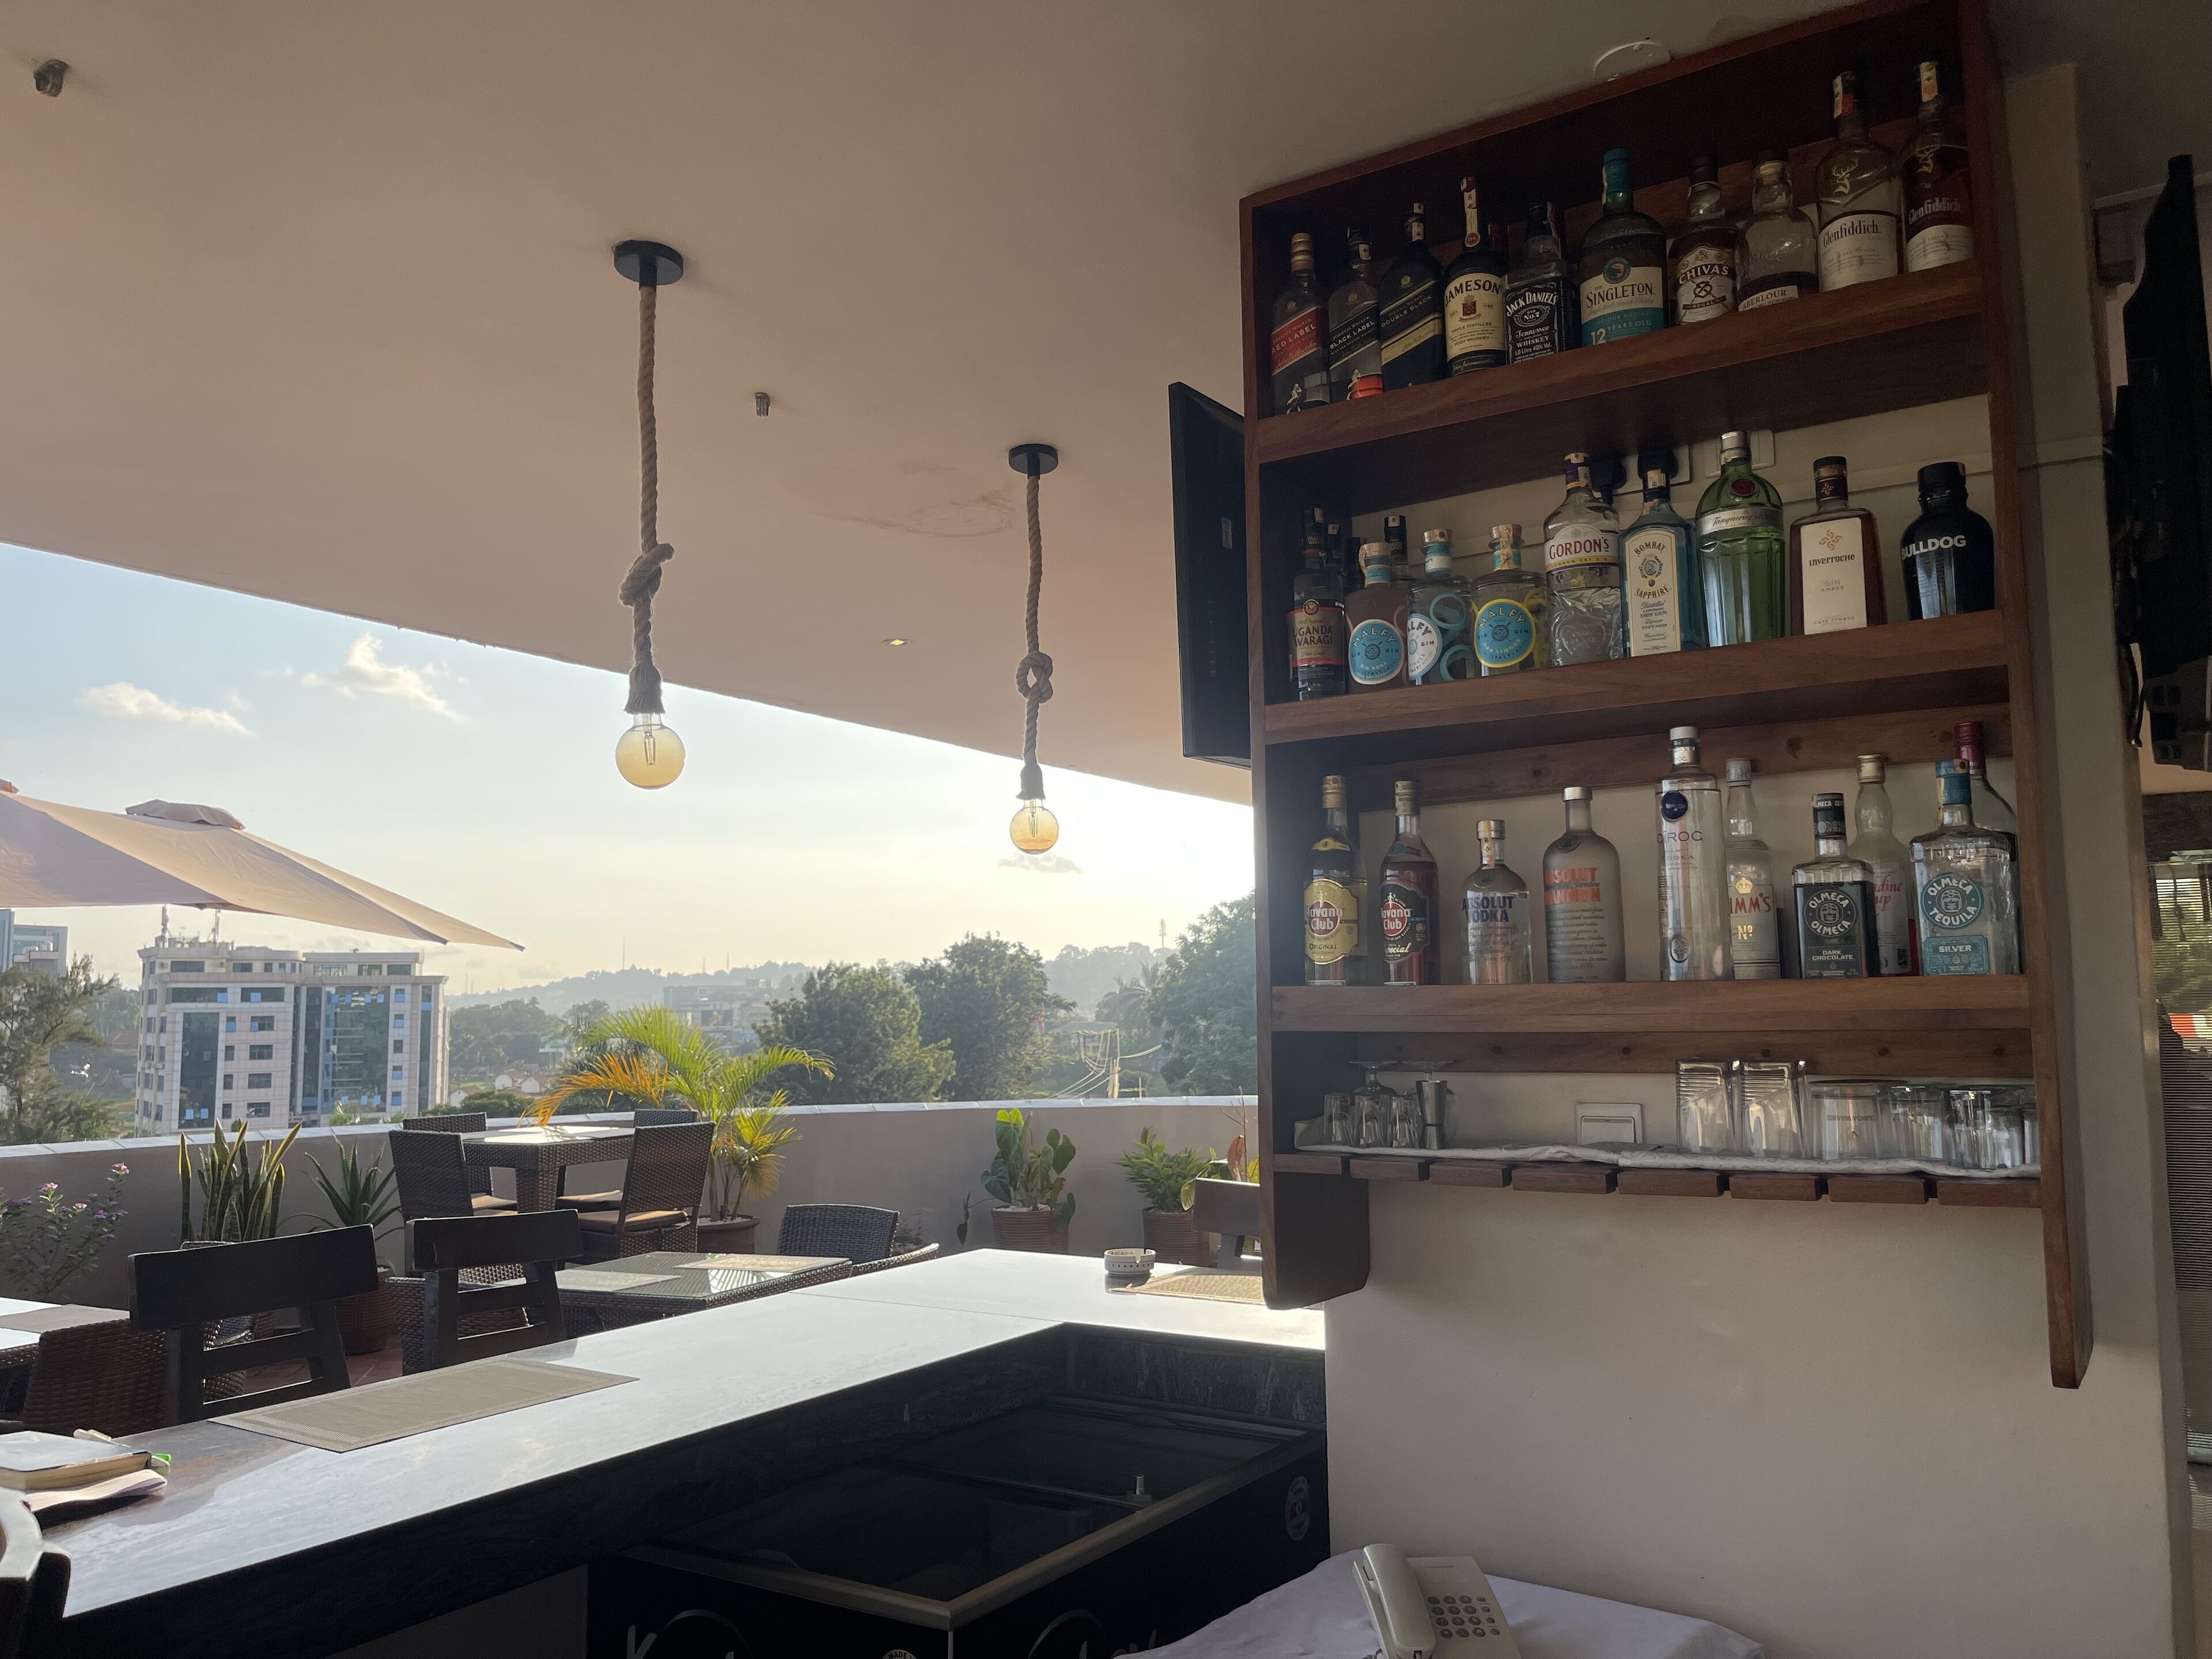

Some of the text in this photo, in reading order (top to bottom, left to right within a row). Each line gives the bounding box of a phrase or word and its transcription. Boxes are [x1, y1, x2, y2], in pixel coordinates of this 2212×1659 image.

[1823, 219, 1879, 248] Glenfiddich
[1679, 265, 1729, 285] CHIVAS
[1445, 279, 1501, 307] JAMESON
[1587, 282, 1653, 308] SINGLETON
[1743, 289, 1787, 310] ABERLOUR
[1381, 295, 1433, 328] DOUBLE BLACK
[1506, 297, 1526, 317] JACK
[1693, 300, 1714, 308] REGAL
[1289, 323, 1317, 343] LABEL
[1516, 325, 1550, 338] Tennessee
[1607, 321, 1633, 331] YEARS
[1330, 321, 1376, 350] BLACK LABEL
[1517, 335, 1550, 347] WHISKEY
[1591, 328, 1606, 345] 12
[1712, 514, 1752, 527] Tanqueray
[1549, 537, 1609, 560] GORDON'S
[1634, 541, 1666, 555] BOMBAY
[1902, 535, 1967, 560] BULLDOG
[1551, 559, 1575, 568] LONDON
[1824, 578, 1840, 587] GIN
[1635, 585, 1670, 599] SAPPHIRE
[1480, 607, 1526, 628] MALFY
[1292, 626, 1333, 638] UGANDA
[1353, 626, 1396, 647] MALFY
[1407, 621, 1432, 637] ALFY
[1294, 635, 1332, 647] WARAGI
[1927, 877, 1973, 896] OLMECA
[1729, 893, 1771, 914] IMM'S
[1809, 892, 1850, 909] OLMECA
[1306, 906, 1343, 918] Havana
[1929, 906, 1978, 926] TEQUILA
[1310, 918, 1334, 931] Club
[1384, 919, 1402, 930] Club
[1811, 921, 1851, 935] OLMECA
[1385, 942, 1412, 954] pecial
[1939, 945, 1972, 953] SILVER
